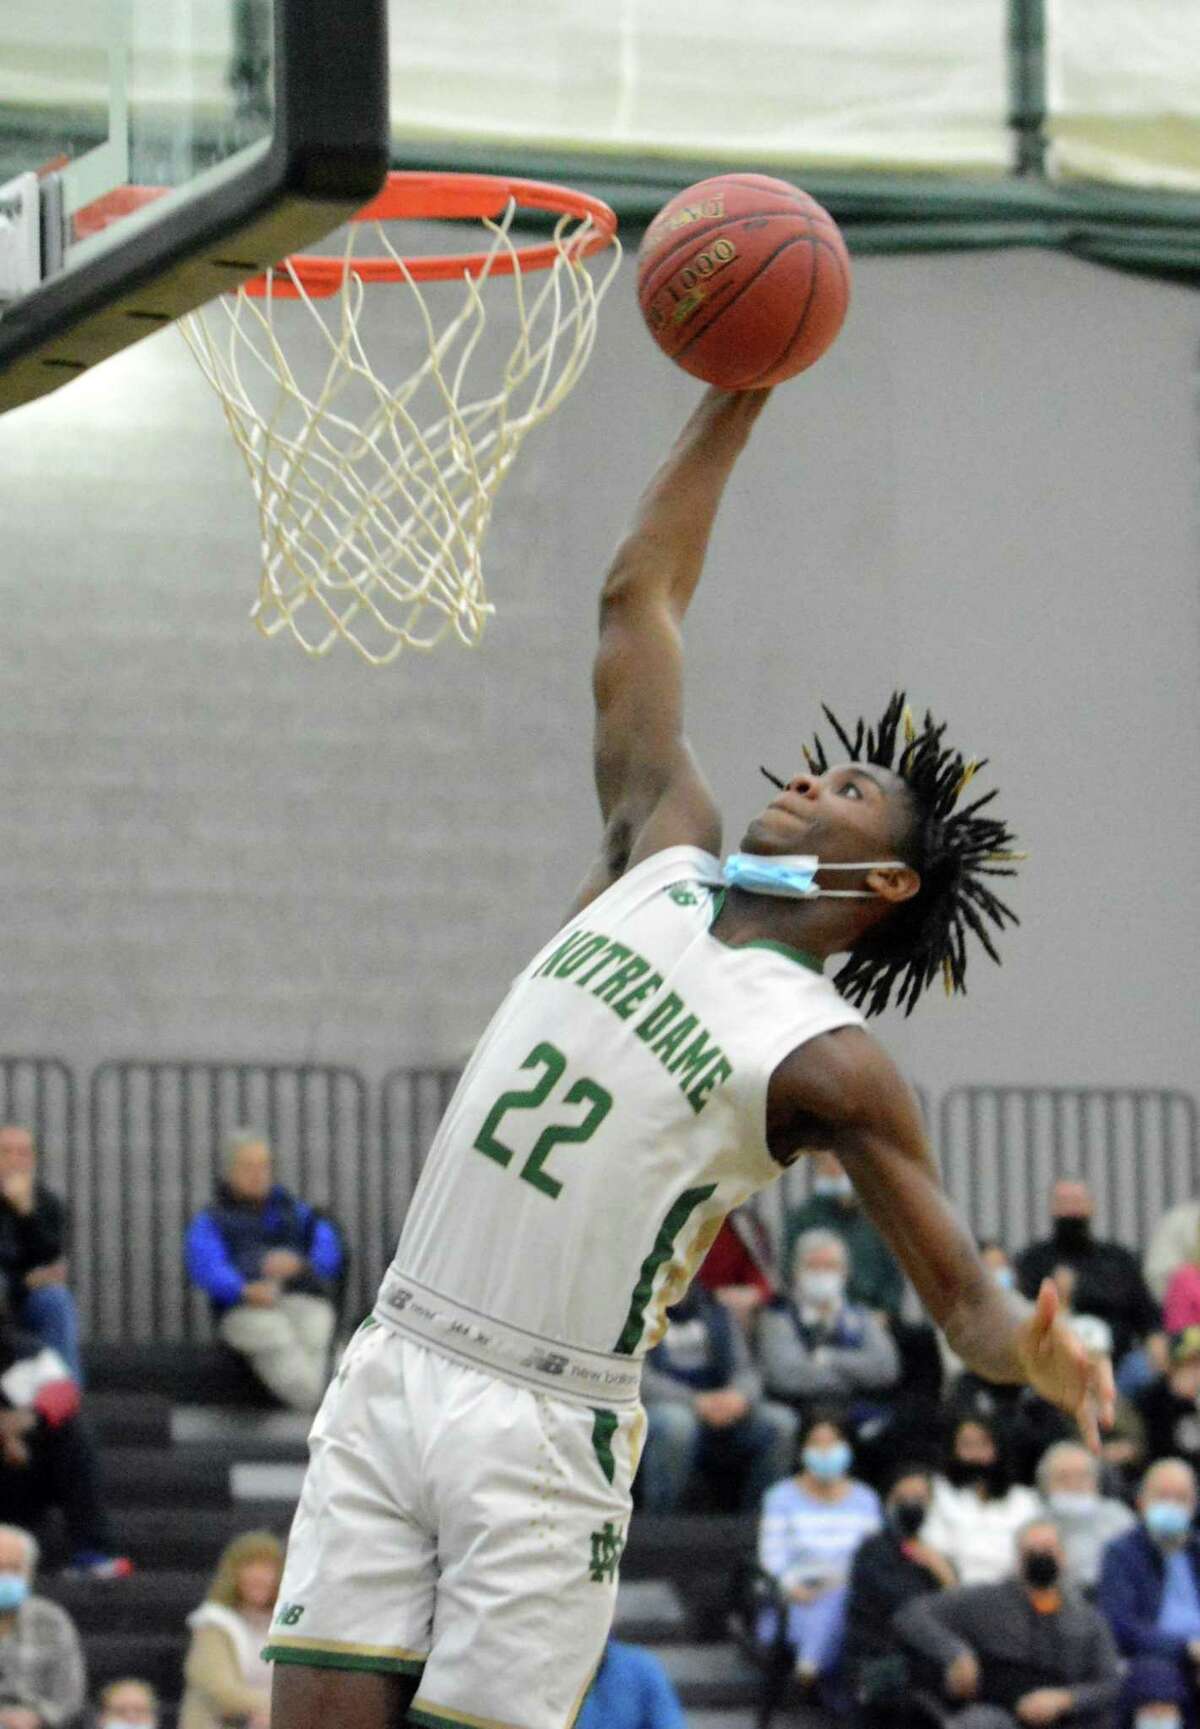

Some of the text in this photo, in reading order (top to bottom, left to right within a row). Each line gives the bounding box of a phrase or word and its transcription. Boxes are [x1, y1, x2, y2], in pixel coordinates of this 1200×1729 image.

[530, 930, 733, 1114] NOTRE DAME
[473, 1041, 613, 1200] 22
